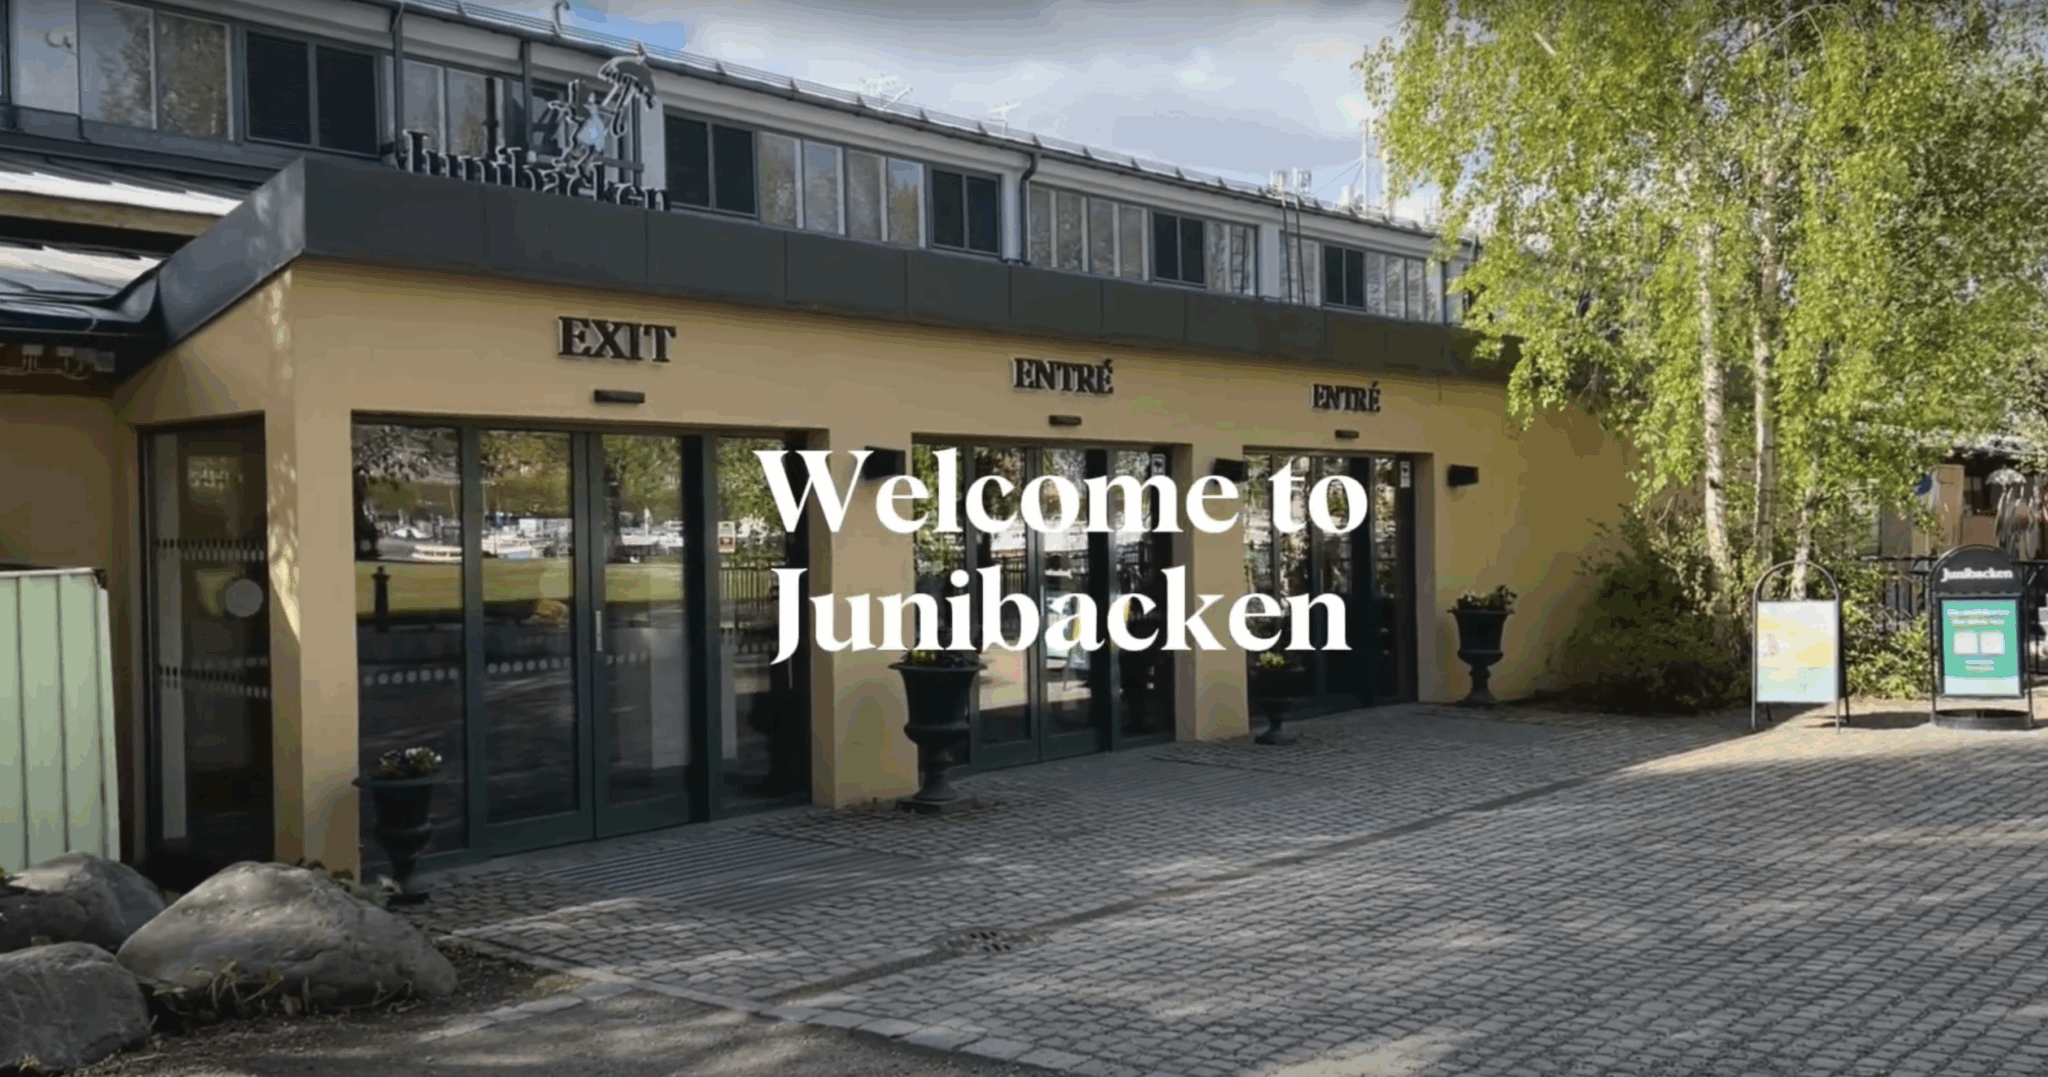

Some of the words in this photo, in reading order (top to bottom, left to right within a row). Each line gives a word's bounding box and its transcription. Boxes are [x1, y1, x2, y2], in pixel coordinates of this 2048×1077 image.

[557, 316, 677, 362] EXIT
[1012, 358, 1114, 394] ENTRÉ
[1311, 381, 1381, 412] ENTRÉ
